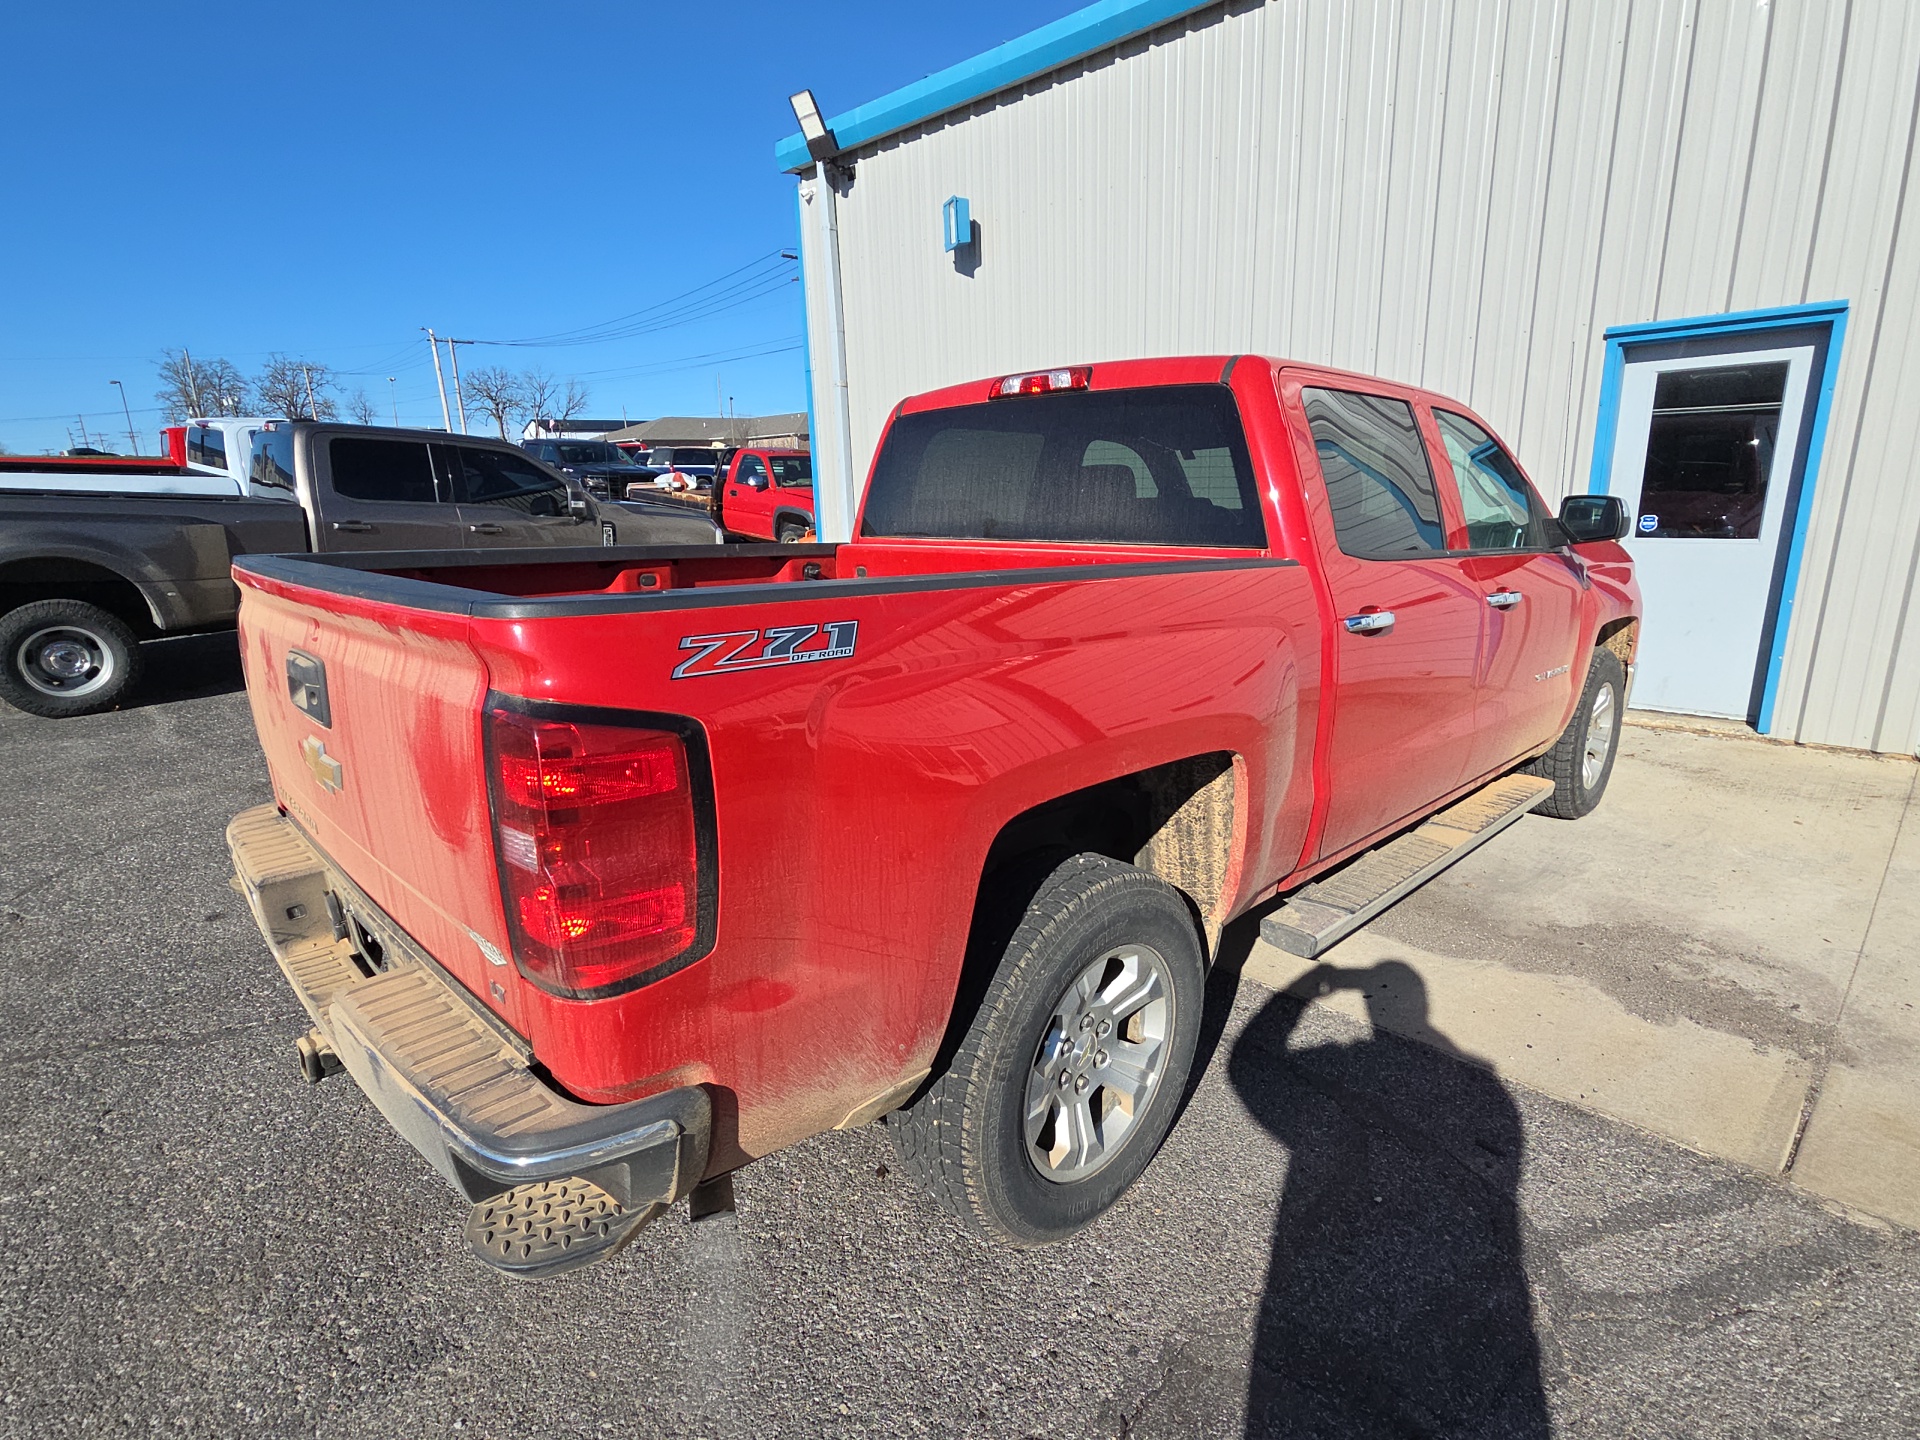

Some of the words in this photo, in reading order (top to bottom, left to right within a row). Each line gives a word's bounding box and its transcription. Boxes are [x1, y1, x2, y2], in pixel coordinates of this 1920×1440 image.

[670, 620, 859, 680] Z71
[792, 651, 815, 662] OFF
[819, 648, 852, 659] ROAD
